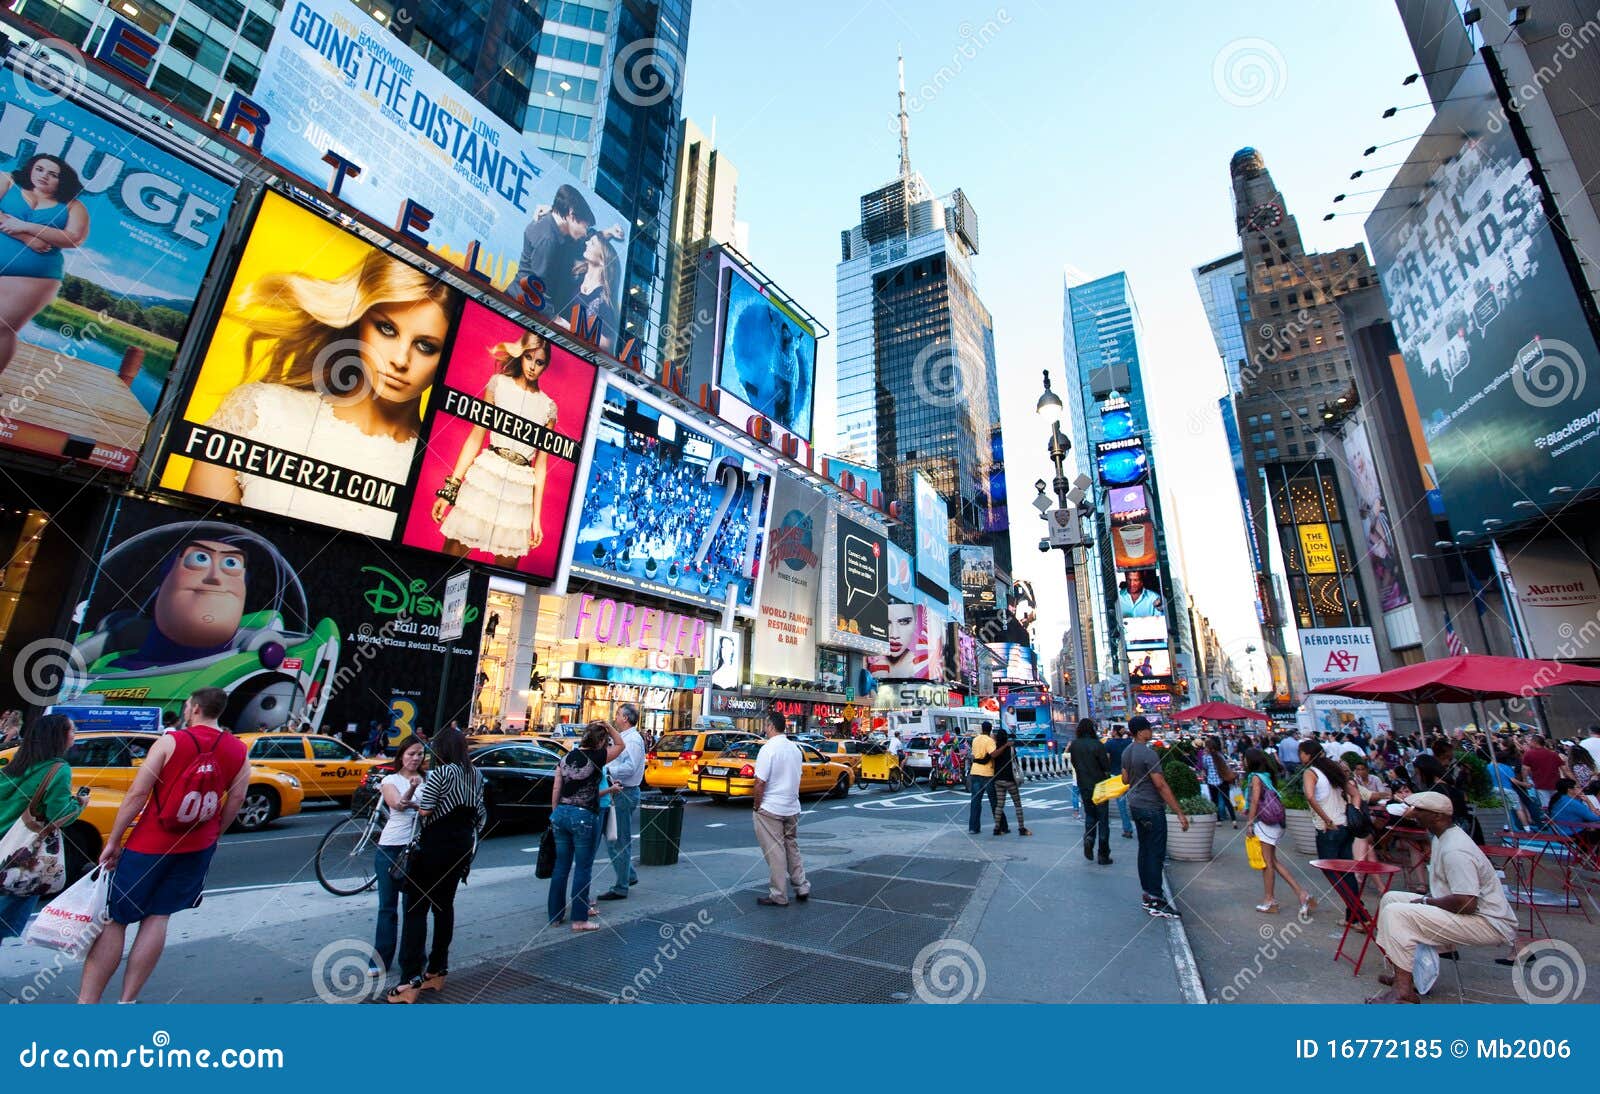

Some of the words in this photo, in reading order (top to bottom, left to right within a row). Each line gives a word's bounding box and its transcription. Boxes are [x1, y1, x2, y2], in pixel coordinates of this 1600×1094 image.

[358, 29, 415, 83] BARRYMORE
[289, 1, 363, 80] GOING
[364, 52, 412, 118] THE
[408, 89, 534, 214] DISTANCE
[472, 116, 500, 149] LONG
[0, 99, 222, 248] HUGE
[1100, 402, 1130, 412] TOSHIBA
[444, 390, 575, 460] FOREVER21.COM
[1098, 437, 1142, 452] TOSHIBA
[92, 446, 131, 463] amily
[185, 427, 396, 508] FOREVER21.COM
[1306, 533, 1323, 542] THE
[1305, 543, 1328, 554] LION
[1307, 555, 1331, 568] KING
[1527, 579, 1585, 597] Marriott
[762, 605, 788, 619] WORLD
[789, 612, 813, 626] FAMOUS
[393, 619, 417, 634] Fall
[420, 624, 442, 637] 201
[575, 594, 705, 658] FOREVER
[767, 619, 808, 637] RESTAURANT
[408, 640, 431, 652] Retail
[432, 644, 473, 656] Expience
[777, 632, 784, 643] &
[785, 635, 799, 646] BAR
[1323, 649, 1359, 673] A87
[727, 698, 757, 710] SWAROVSKI
[900, 688, 949, 707] swat
[177, 790, 219, 823] 08
[43, 905, 74, 920] THANK
[74, 914, 93, 923] YOU
